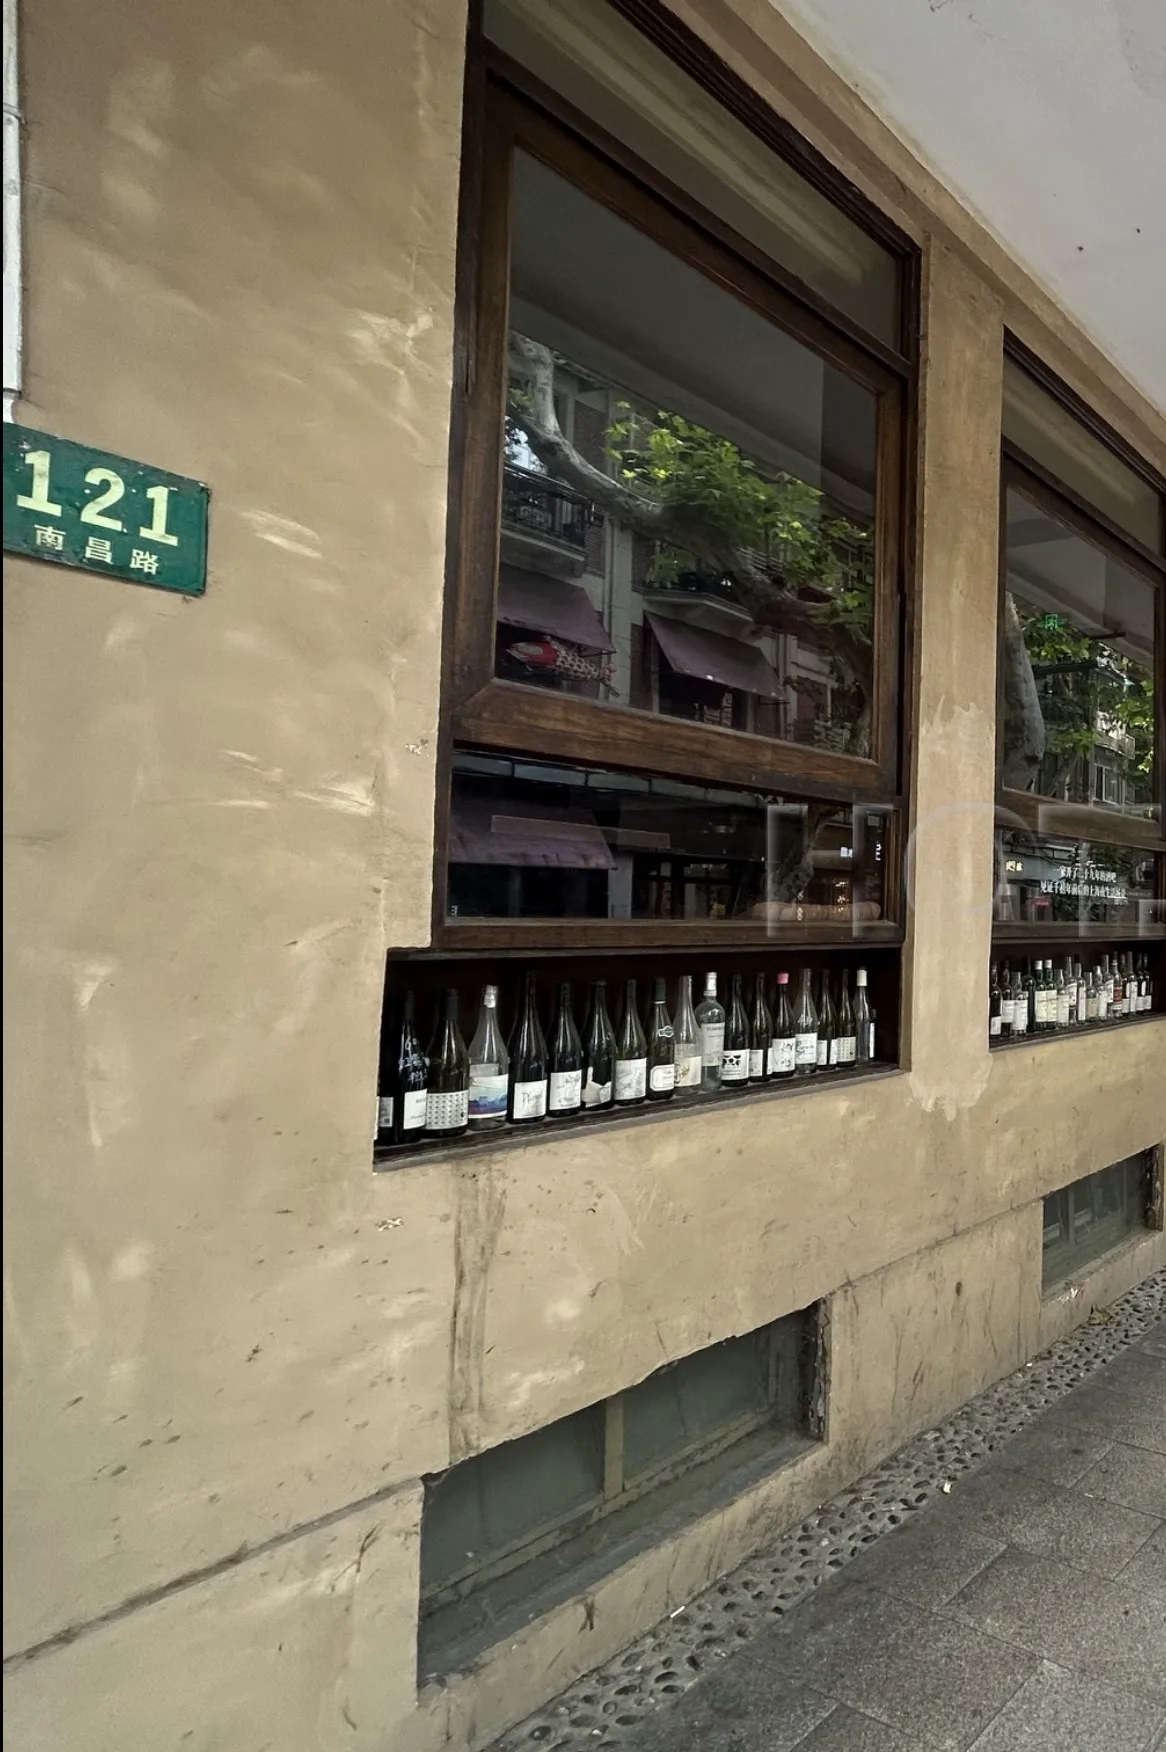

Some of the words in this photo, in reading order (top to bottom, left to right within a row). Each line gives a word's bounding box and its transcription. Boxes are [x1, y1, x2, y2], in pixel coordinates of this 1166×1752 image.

[17, 450, 179, 547] 121
[34, 524, 160, 575] 南昌路
